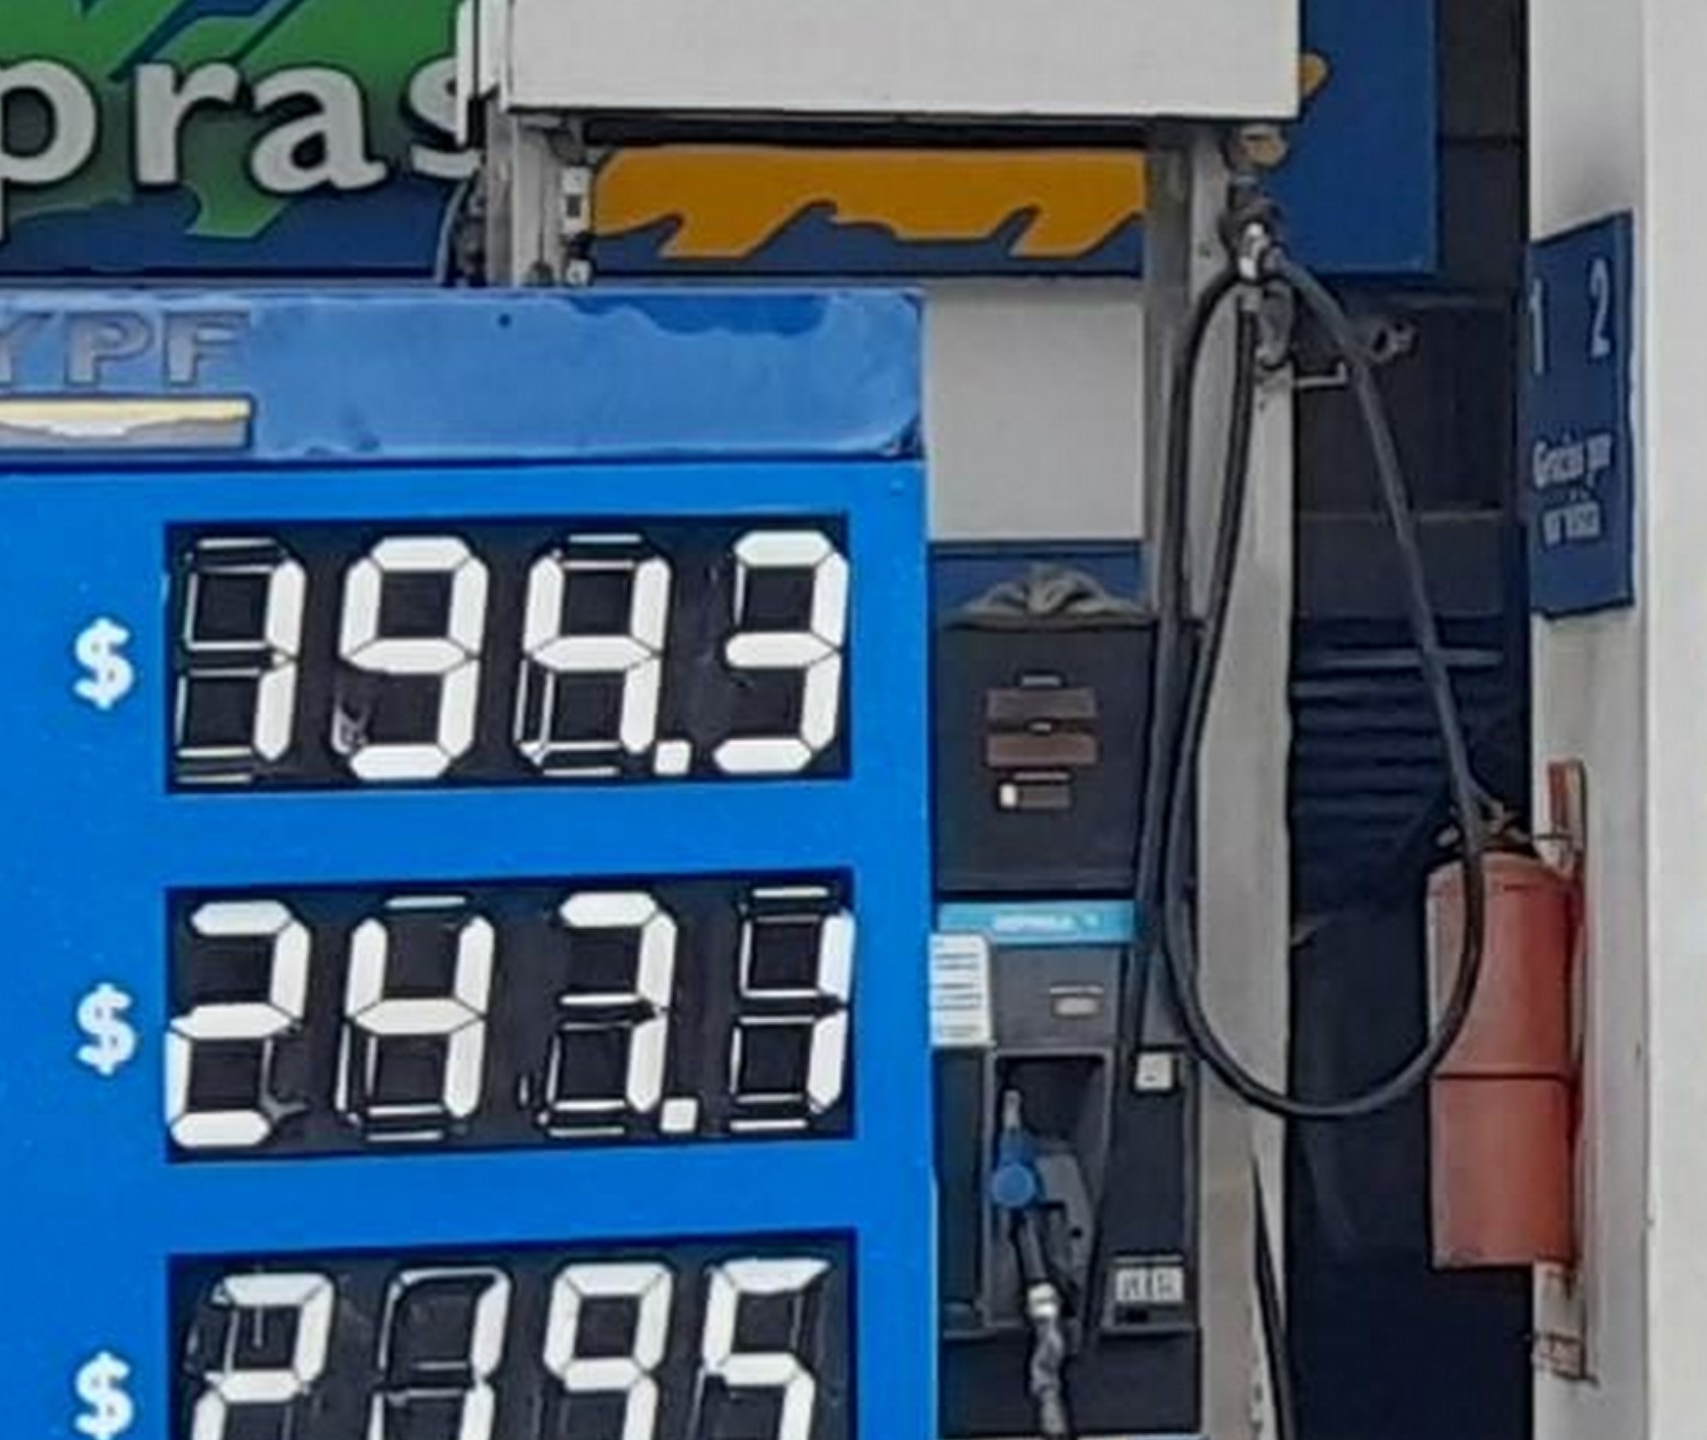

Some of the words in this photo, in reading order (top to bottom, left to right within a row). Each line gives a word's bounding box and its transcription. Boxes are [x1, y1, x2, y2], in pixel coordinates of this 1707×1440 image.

[1590, 257, 1612, 358] 2
[74, 618, 134, 710] $
[252, 530, 850, 783] 194.3
[76, 982, 137, 1076] $
[165, 891, 854, 1149] 247.1
